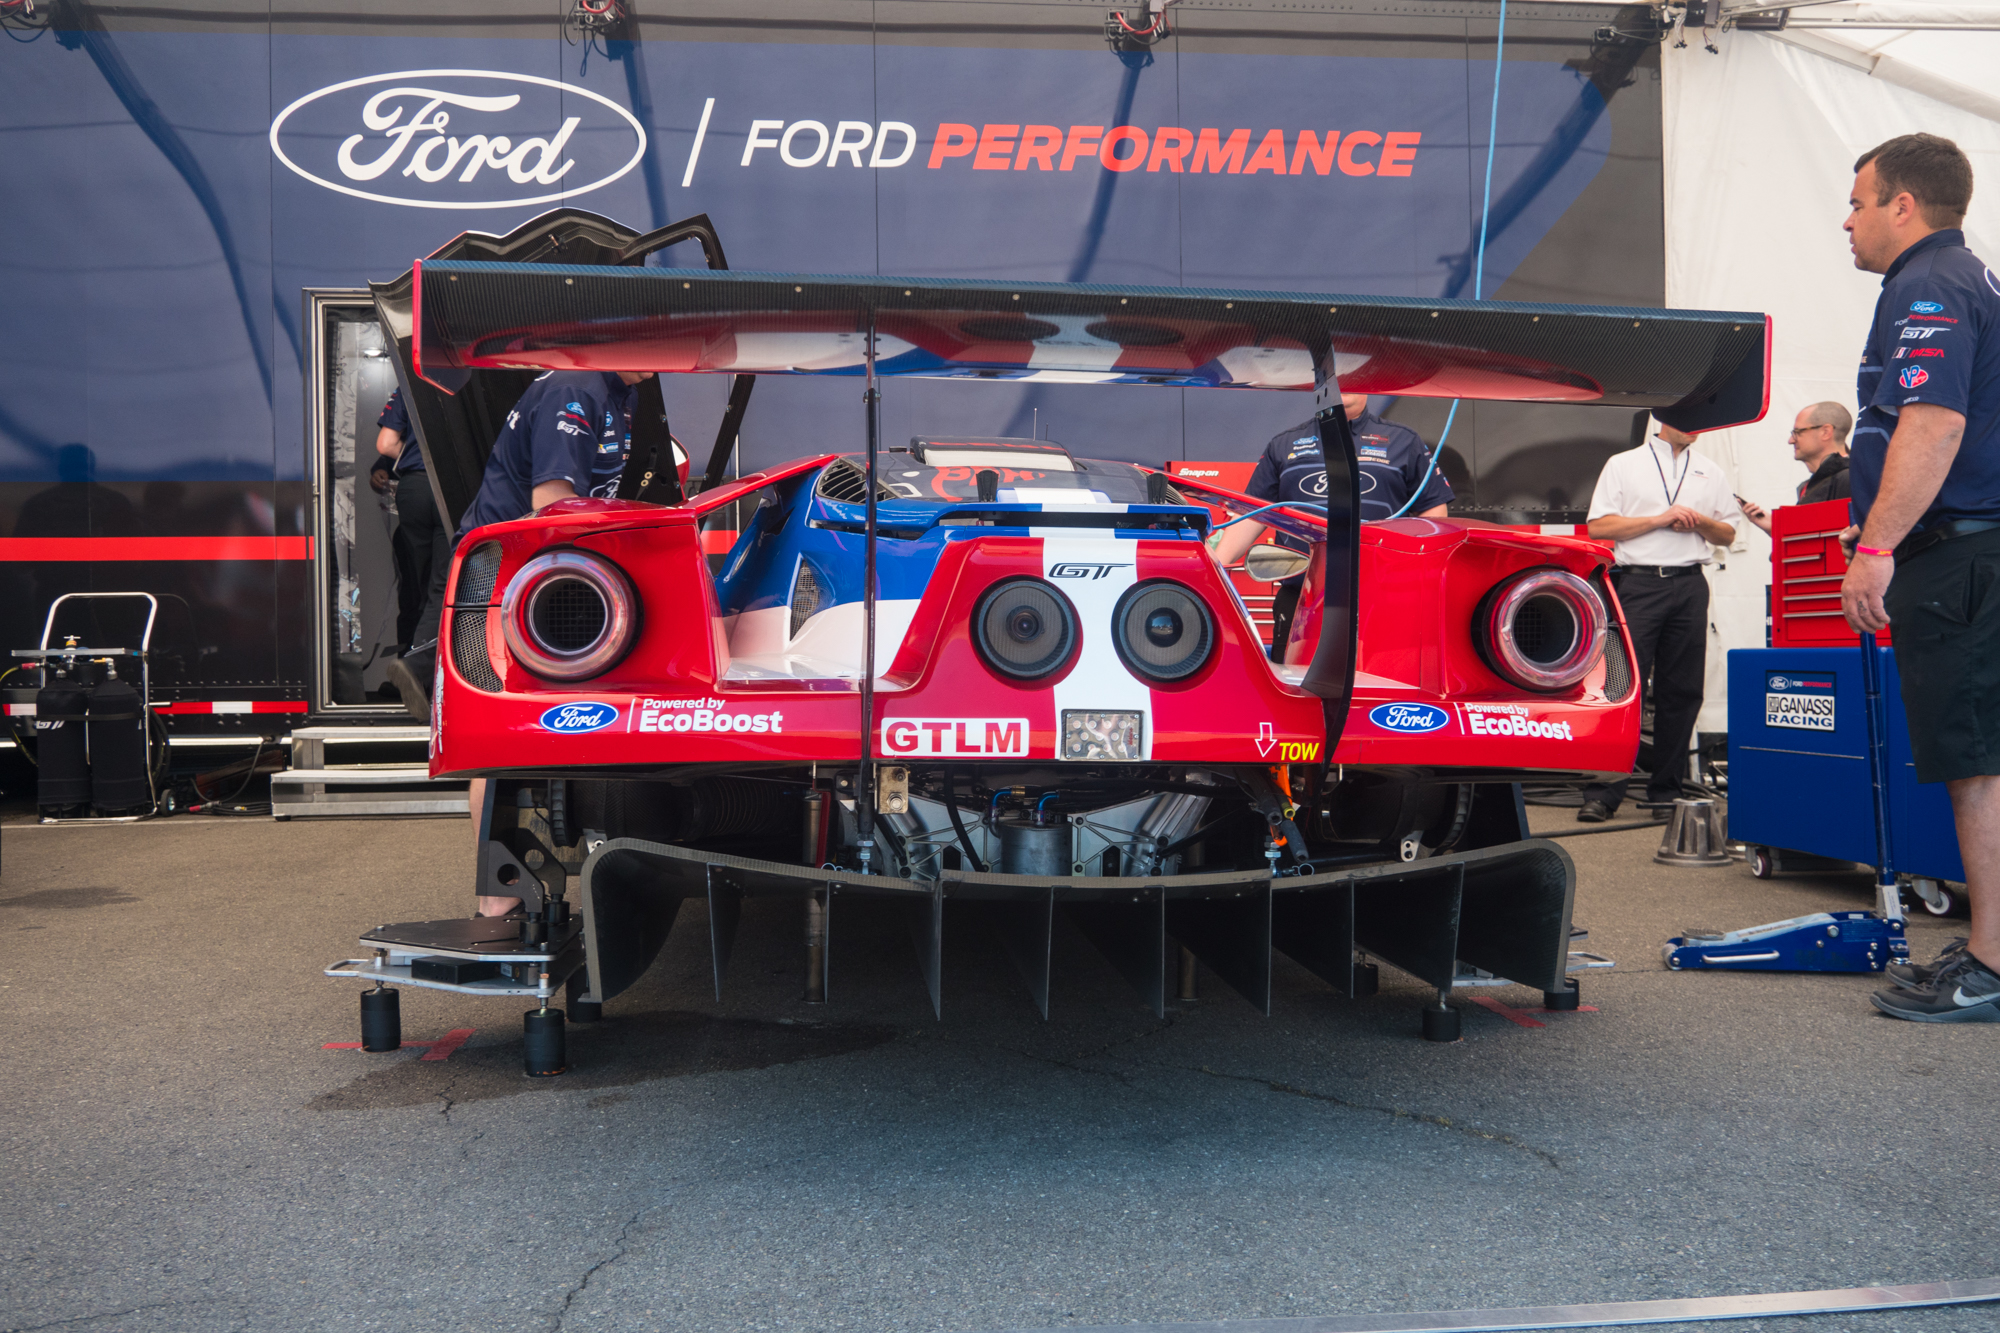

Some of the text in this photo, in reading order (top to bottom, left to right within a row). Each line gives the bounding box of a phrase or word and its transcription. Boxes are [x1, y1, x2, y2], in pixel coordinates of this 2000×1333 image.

[337, 87, 581, 186] Ford
[740, 119, 1422, 177] FORD PERFORMANCE
[1913, 303, 1937, 312] Ford
[1908, 314, 1958, 324] PERFORMANCE
[1901, 365, 1920, 388] VP
[1178, 467, 1219, 478] Snap-on
[1048, 562, 1135, 581] GT
[642, 697, 726, 711] Powered by
[1464, 702, 1529, 717] Powered by
[1779, 697, 1833, 716] GANASSI
[553, 705, 605, 729] Ford
[639, 709, 783, 733] EcoBoost
[1385, 705, 1435, 727] Ford
[1768, 713, 1833, 728] RACING
[1468, 713, 1573, 741] EcoBoost
[885, 721, 1022, 753] GTLM
[1279, 742, 1320, 761] TOW
